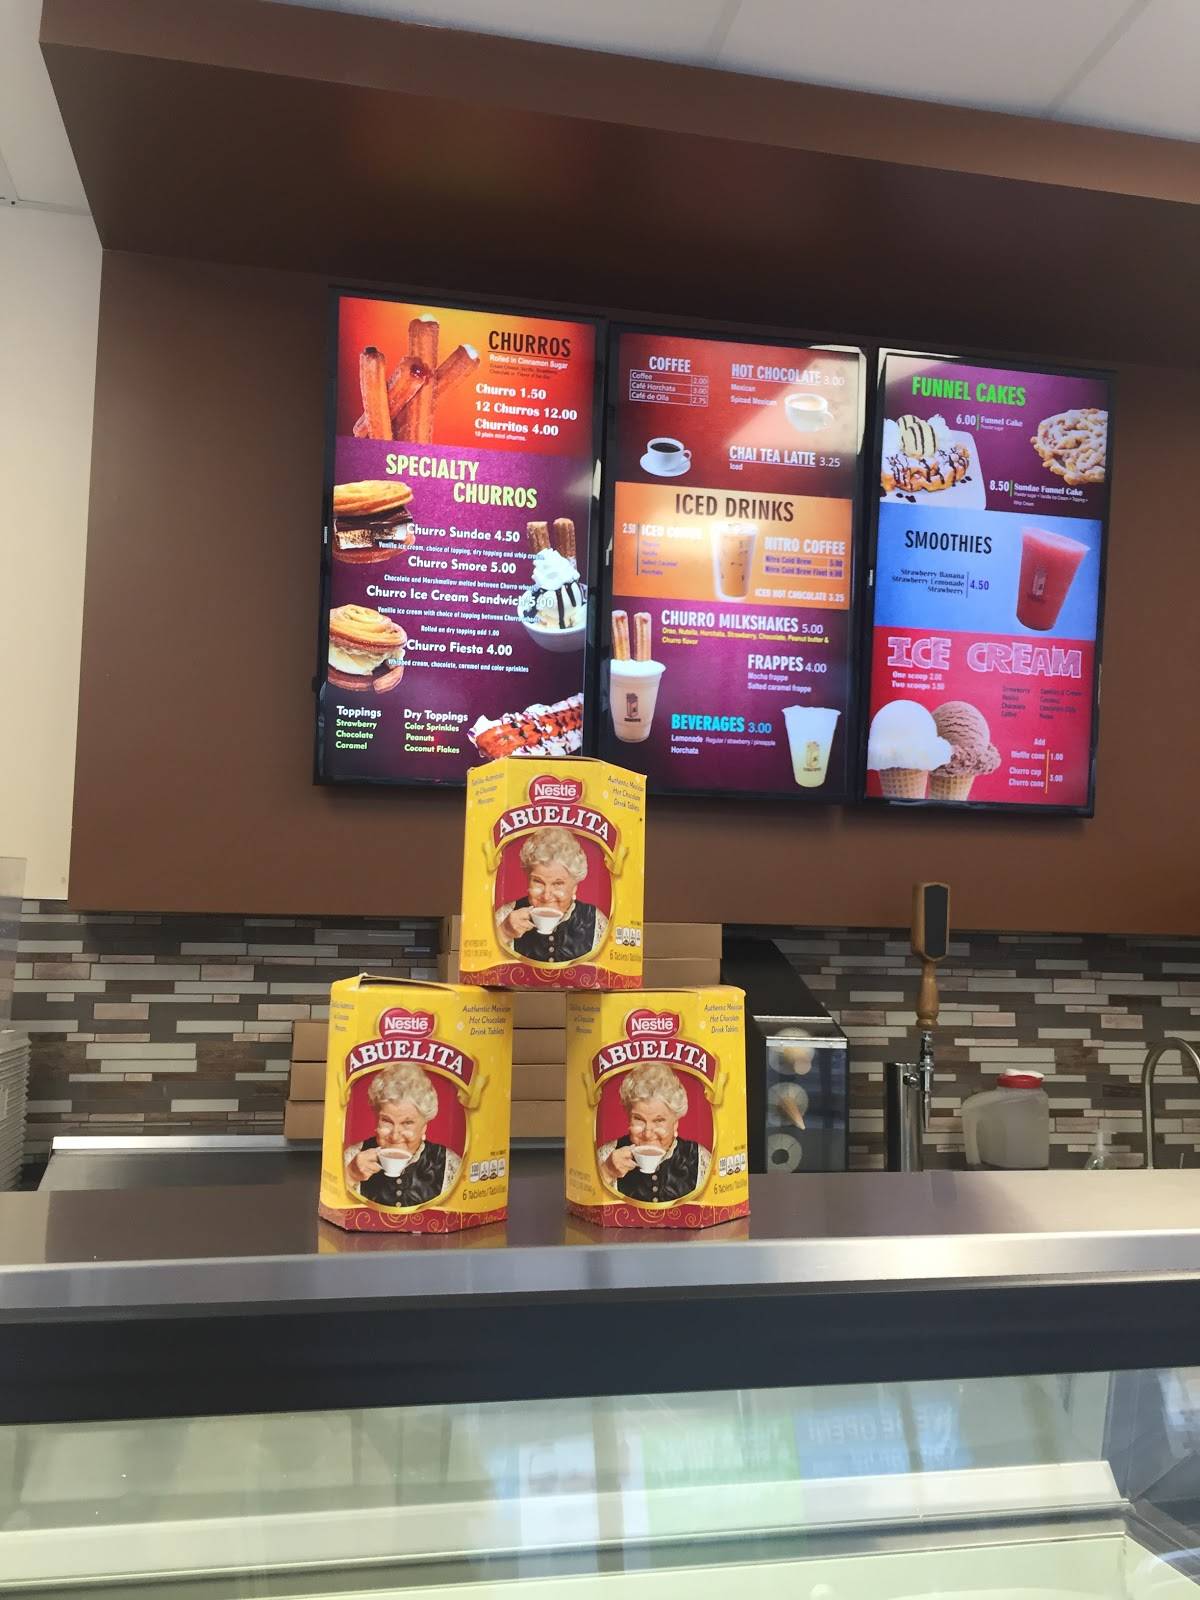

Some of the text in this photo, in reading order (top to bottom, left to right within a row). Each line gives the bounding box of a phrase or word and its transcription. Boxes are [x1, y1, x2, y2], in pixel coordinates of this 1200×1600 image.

[489, 331, 571, 357] CHURROS
[489, 354, 509, 363] Rolled
[518, 357, 549, 367] Cinnamon
[550, 360, 568, 370] Sugar
[649, 356, 691, 372] COFFEE
[632, 372, 652, 380] Coffee
[732, 364, 845, 386] HOT CHOCOLATE 3.00
[476, 383, 547, 400] Churro 1.50
[647, 383, 676, 392] Horchata
[912, 376, 1026, 407] FUNNEL CAKES
[632, 392, 646, 400] Café
[475, 401, 578, 420] 12 Churros 12.00
[475, 418, 559, 436] Churritos 4.00
[956, 414, 976, 426] 6.00
[980, 416, 1004, 426] Funnel
[1006, 418, 1024, 428] Cake
[730, 446, 840, 468] CHAI TEA LATTE 3.25
[385, 454, 480, 482] SPECIALTY
[989, 480, 1084, 496] 8.50 Sundae Funnel Cake
[453, 482, 538, 509] CHURROS
[676, 493, 794, 522] ICED DRINKS
[407, 524, 520, 542] Churro Sundae 4.50
[764, 536, 846, 556] NITRO COFFEE
[905, 529, 992, 554] SMOOTHIES
[483, 550, 503, 558] topping
[408, 556, 516, 574] Churro Smore 5.00
[384, 574, 410, 582] Chocolate
[422, 577, 458, 586] Marshmallow
[900, 568, 964, 580] Strawberry Banana
[892, 576, 964, 587] Strawberry Lemonade
[970, 580, 990, 590] 4.50
[366, 585, 526, 606] Churro Ice Cream Sandwich
[928, 586, 963, 594] Strawberry
[460, 612, 480, 620] topping
[661, 610, 824, 634] CHURRO MILKSHAKES 5.00
[456, 628, 476, 636] topping
[406, 639, 512, 656] Churro Fiesta 4.00
[888, 636, 1082, 678] ICE CREAM
[748, 654, 828, 673] FRAPPES 4.00
[748, 672, 788, 682] Mocha frappe
[892, 670, 906, 678] One
[748, 682, 768, 690] Salted
[792, 684, 812, 694] frappe
[892, 680, 906, 688] Two
[336, 705, 382, 719] Toppings
[404, 708, 468, 723] Dry Toppings
[336, 718, 378, 730] Strawberry
[404, 722, 460, 732] Color Sprinkles
[671, 713, 772, 734] BEVERAGES 3.00
[336, 730, 374, 739] Chocolate
[406, 734, 434, 742] Peanuts
[671, 734, 704, 743] Lemonade
[336, 741, 368, 750] Caramel
[1033, 738, 1046, 746] Add
[404, 744, 460, 754] Coconut Flakes
[671, 746, 699, 754] Horchata
[1050, 752, 1064, 760] 1.00
[1009, 766, 1042, 778] Churro cup
[1008, 778, 1029, 786] Churro
[500, 806, 609, 841] ABUELITA
[463, 1004, 490, 1014] Authentic
[468, 1016, 480, 1024] Hot
[470, 1026, 486, 1036] Drink
[349, 1040, 464, 1076] ABUELITA
[598, 1040, 708, 1073] ABUELITA
[462, 1190, 468, 1200] 6
[714, 1183, 718, 1195] 6
